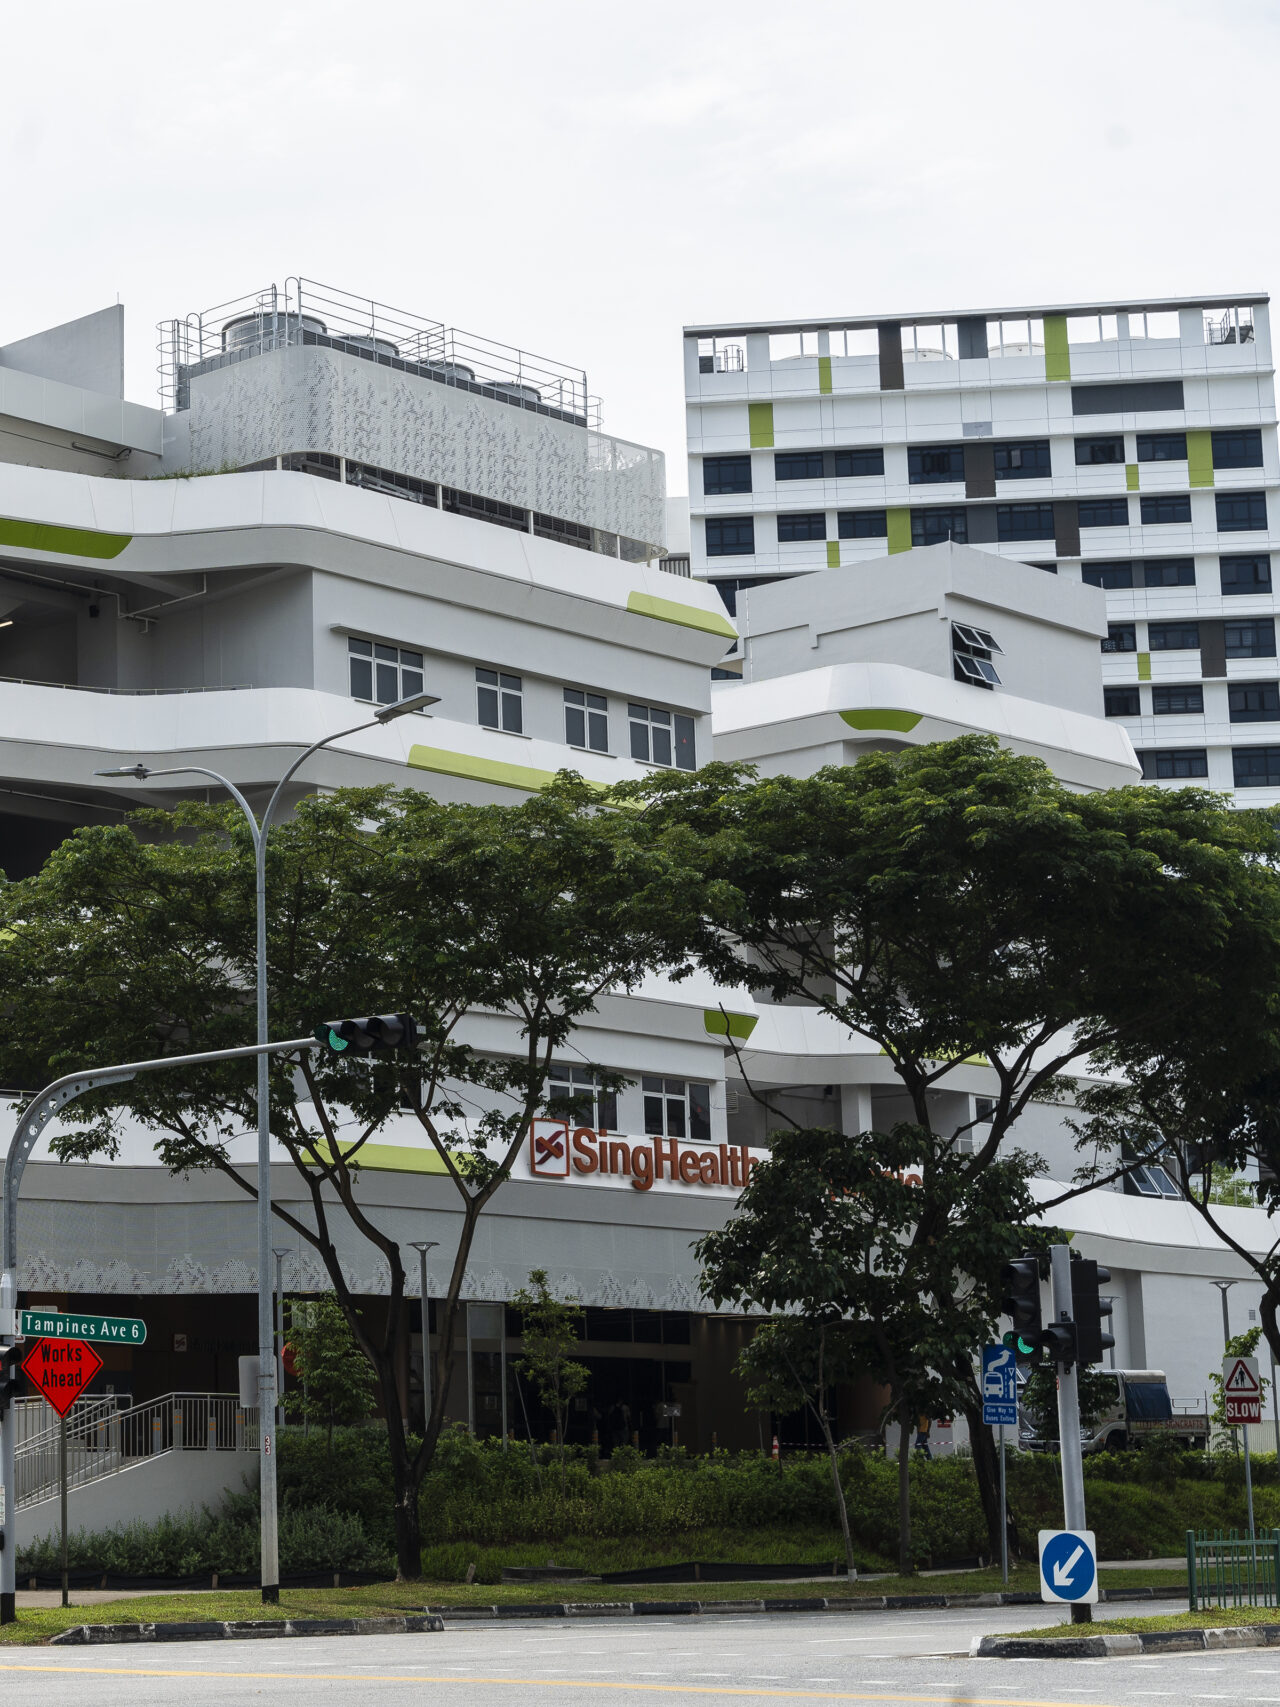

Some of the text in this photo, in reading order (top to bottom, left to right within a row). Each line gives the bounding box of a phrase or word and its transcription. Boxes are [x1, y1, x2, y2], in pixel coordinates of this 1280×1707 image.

[572, 1127, 759, 1191] SingHealth
[25, 1314, 139, 1339] Tampines Ave 6
[41, 1343, 82, 1363] Works
[41, 1367, 82, 1388] Ahead
[998, 1407, 1007, 1415] Way
[1226, 1402, 1260, 1418] SLOW
